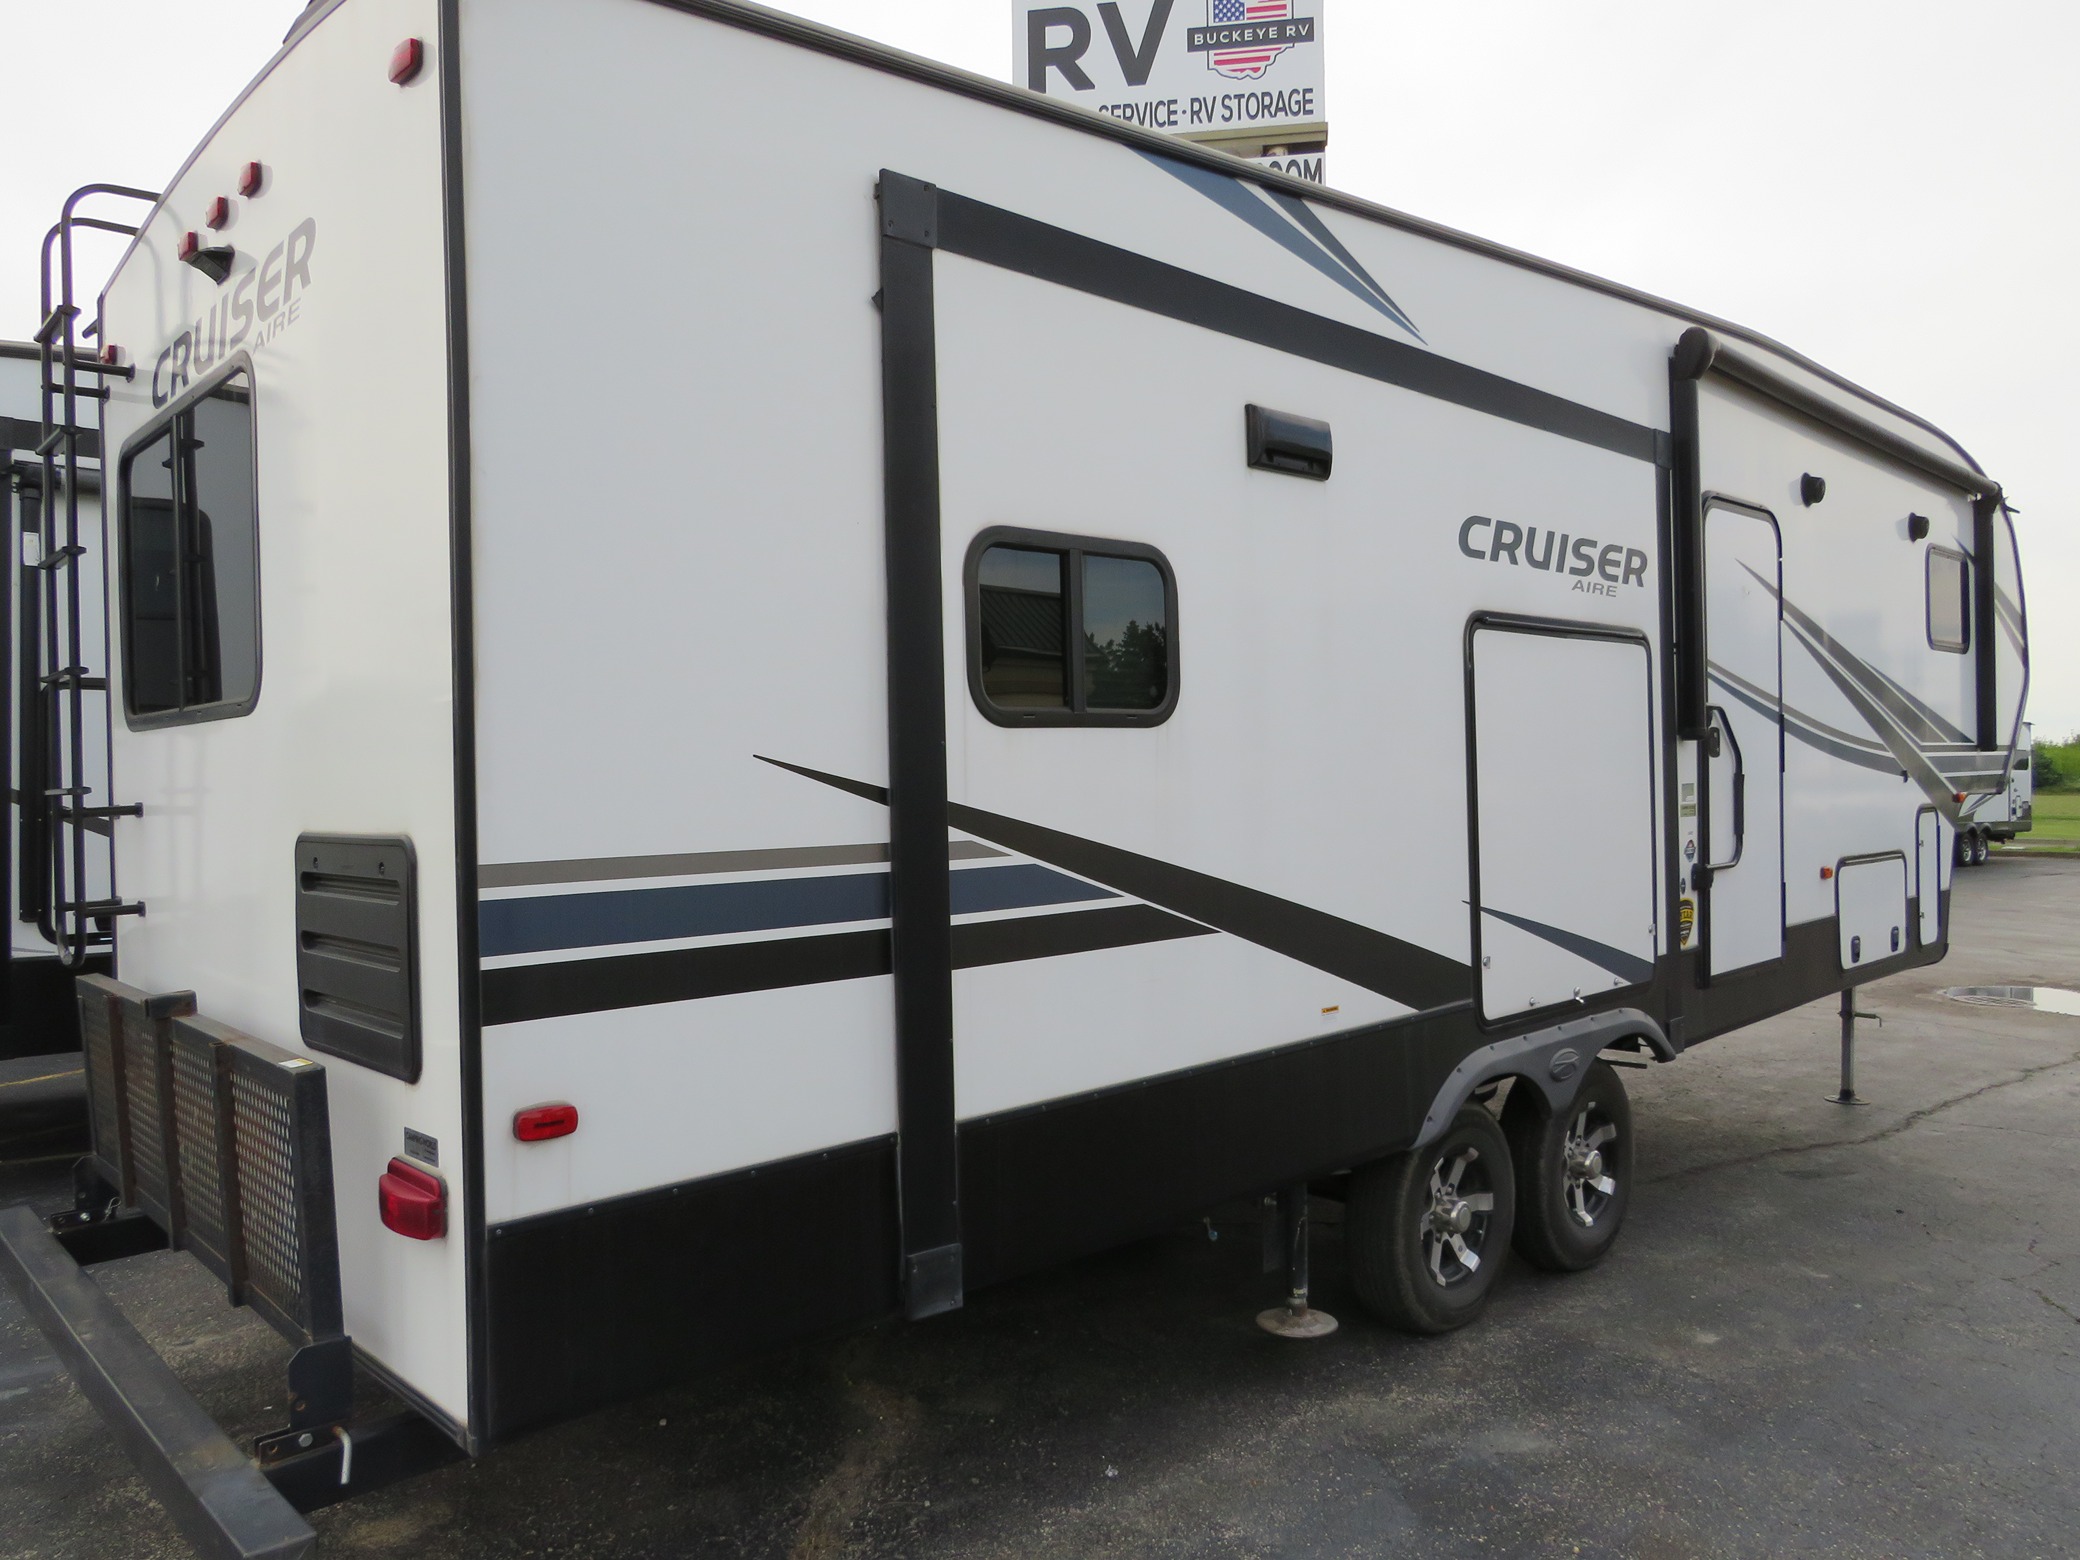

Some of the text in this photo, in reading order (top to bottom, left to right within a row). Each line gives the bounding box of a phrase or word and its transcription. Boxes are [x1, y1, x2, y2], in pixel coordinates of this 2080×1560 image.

[1028, 0, 1174, 94] RV
[1194, 23, 1310, 46] BUCKEYE RV
[1190, 95, 1217, 124] RV
[1220, 88, 1314, 122] STORAGE
[153, 217, 316, 410] CRUISER
[253, 297, 302, 355] AIRE
[1458, 515, 1648, 587] CRUISER
[1571, 579, 1618, 598] AIRE
